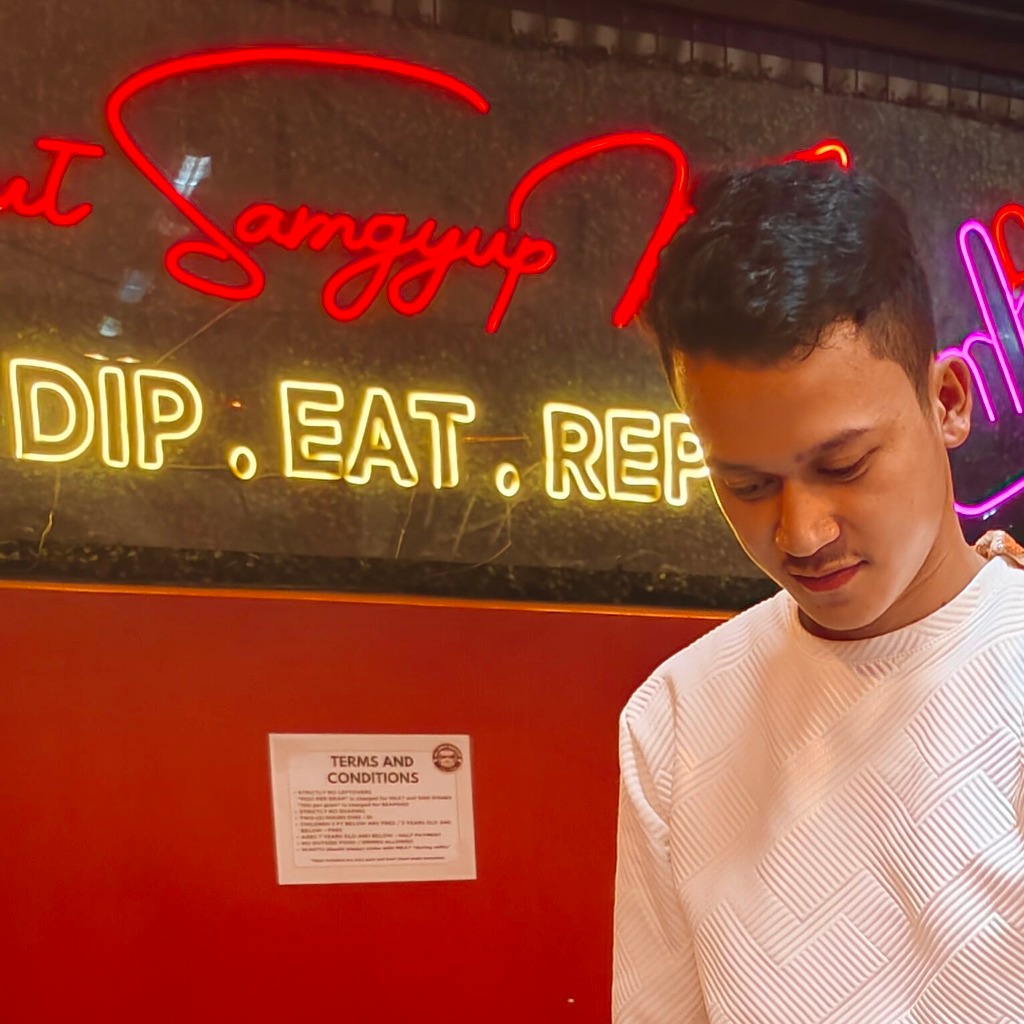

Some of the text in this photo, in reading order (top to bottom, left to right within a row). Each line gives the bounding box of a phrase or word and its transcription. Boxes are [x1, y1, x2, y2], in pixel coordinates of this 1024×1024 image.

[105, 46, 557, 333] Samgyup
[10, 357, 203, 470] DIP
[280, 380, 476, 488] EAT
[542, 402, 709, 507] REP
[327, 772, 420, 784] CONDITIONS
[330, 755, 414, 768] TERMS AND
